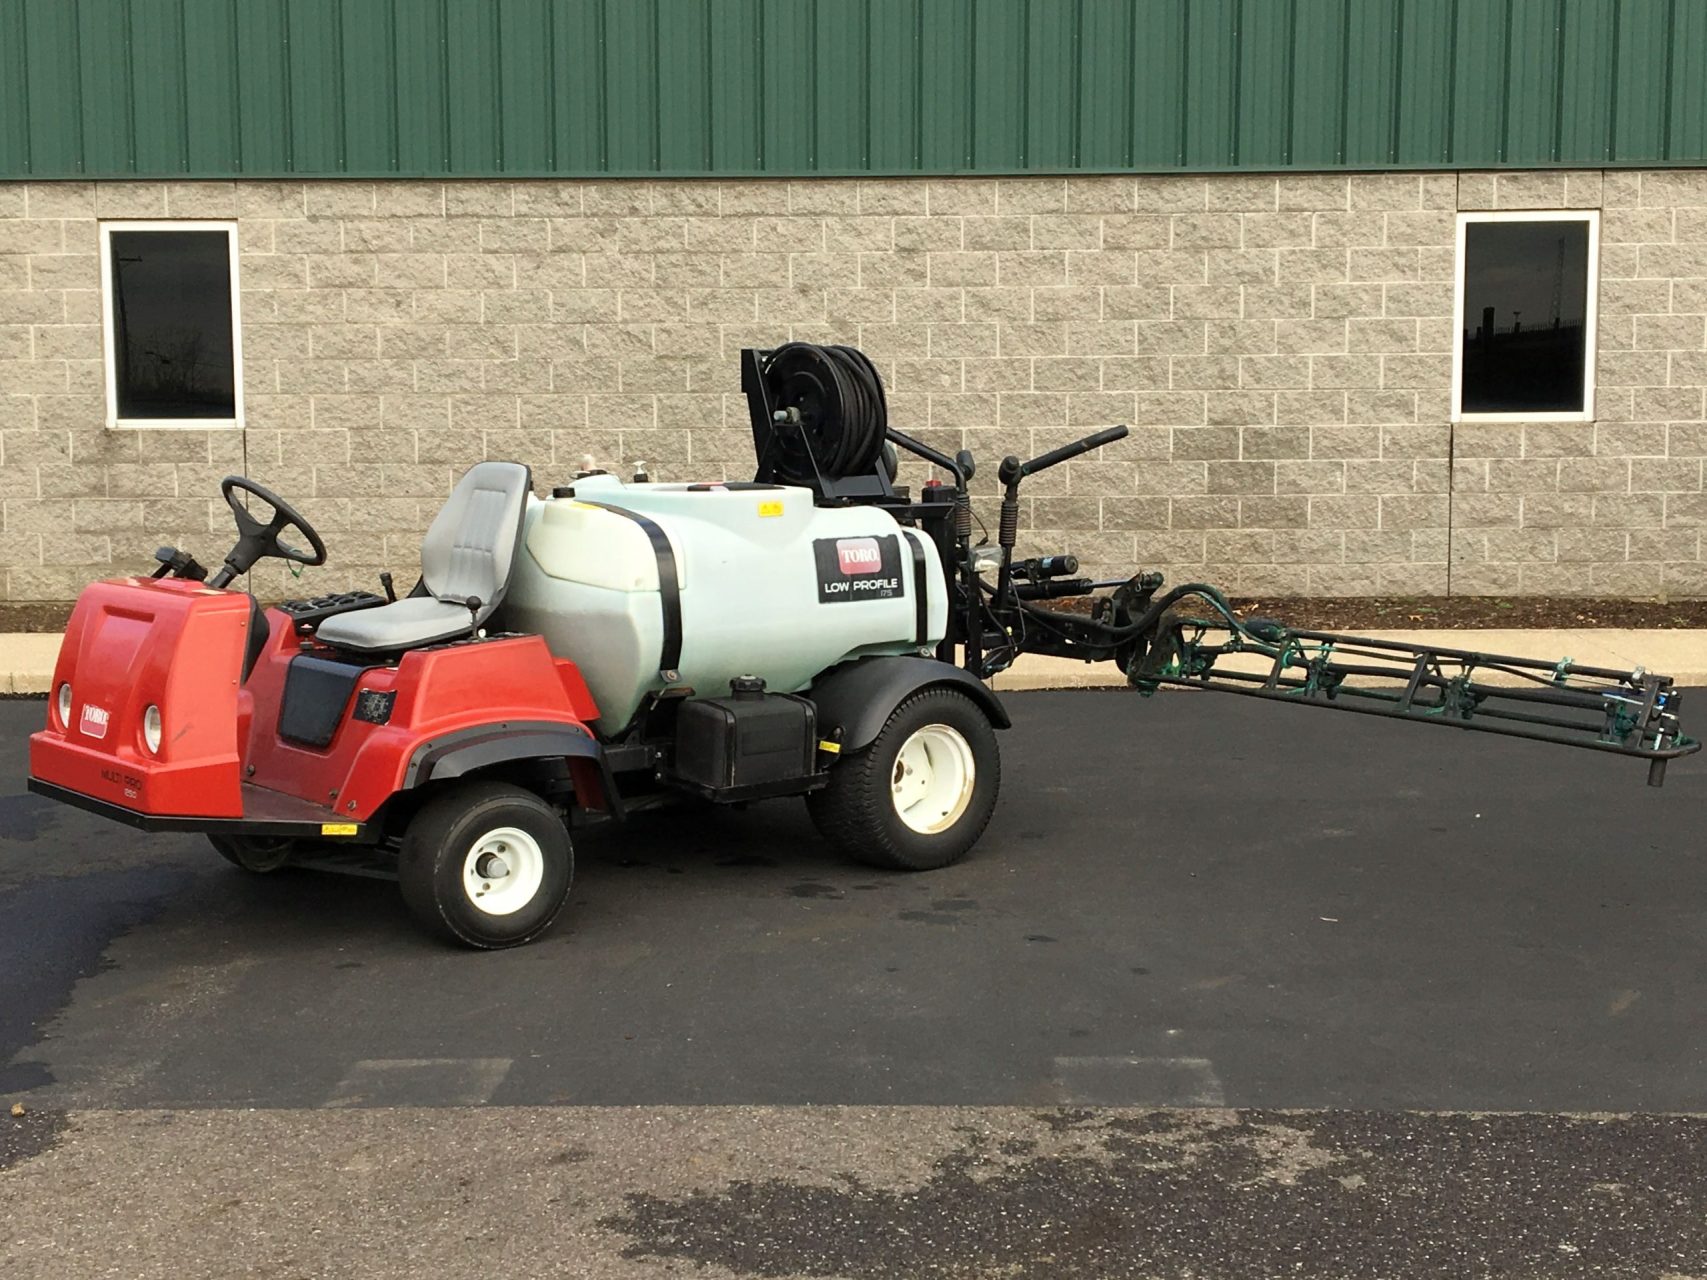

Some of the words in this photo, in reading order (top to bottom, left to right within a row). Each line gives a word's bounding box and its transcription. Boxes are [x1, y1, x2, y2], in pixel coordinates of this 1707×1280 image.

[842, 548, 878, 564] TORO
[824, 582, 850, 593] LOW
[853, 578, 898, 591] PROFILE
[84, 705, 109, 725] TORO
